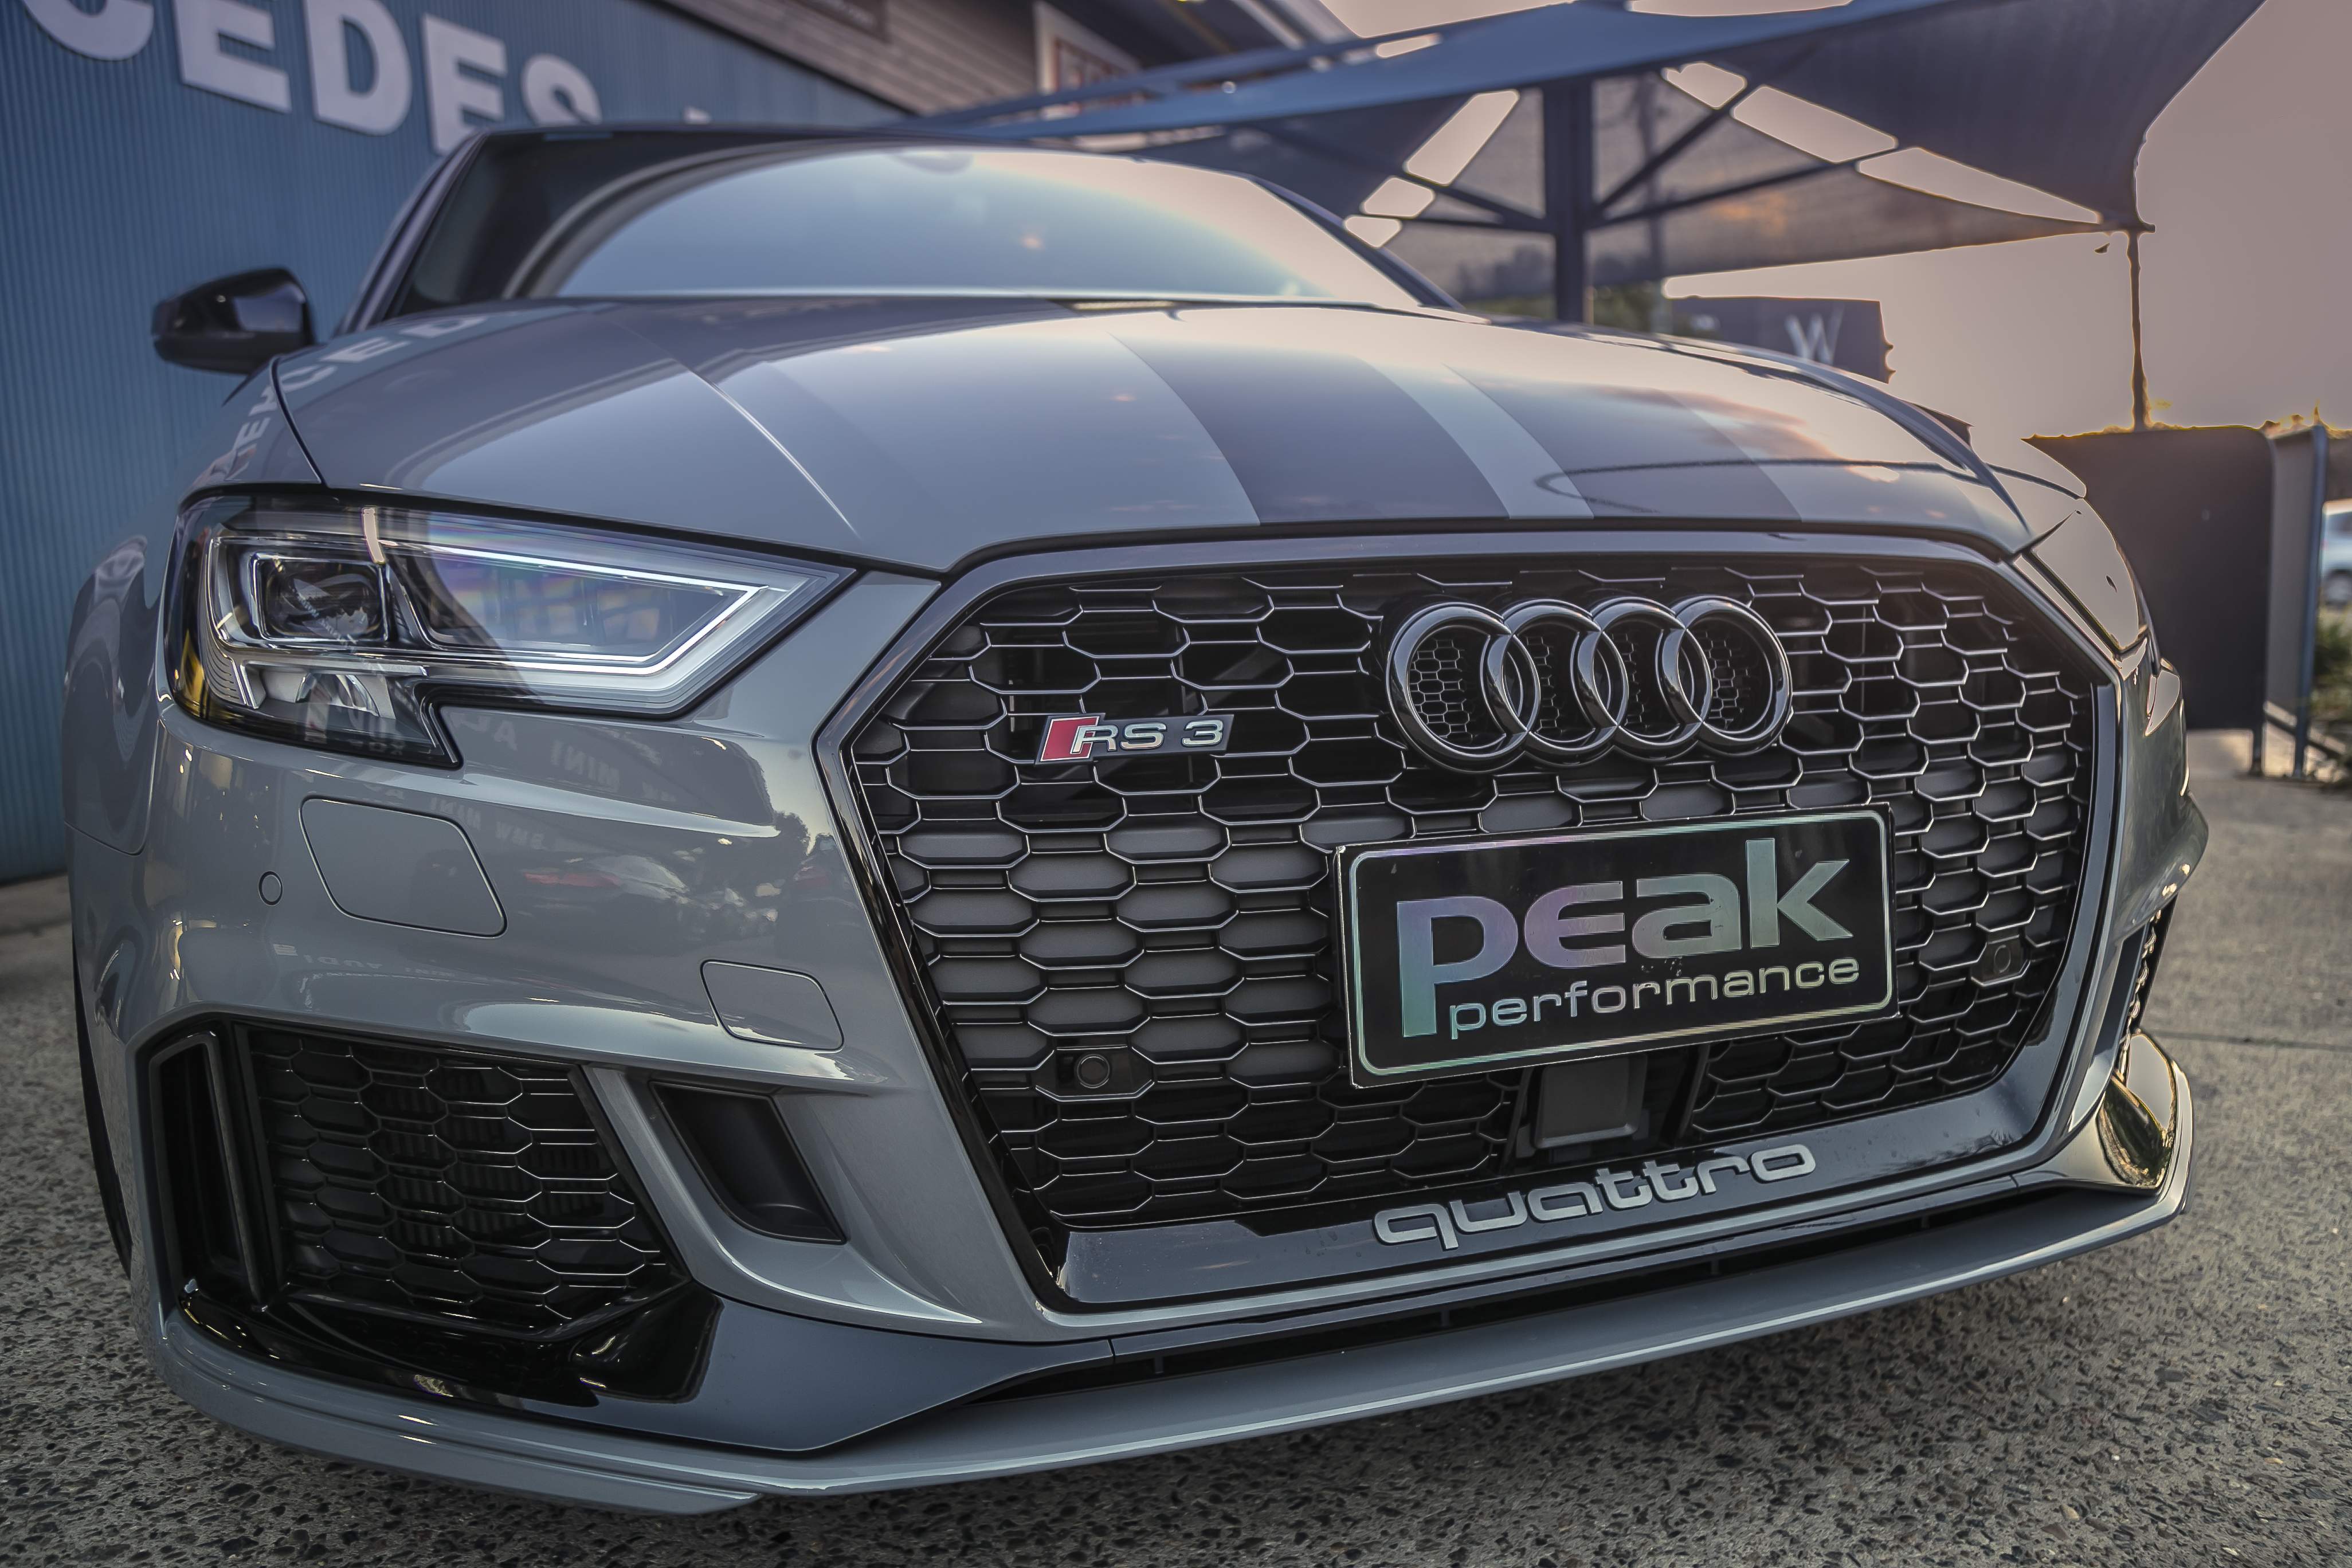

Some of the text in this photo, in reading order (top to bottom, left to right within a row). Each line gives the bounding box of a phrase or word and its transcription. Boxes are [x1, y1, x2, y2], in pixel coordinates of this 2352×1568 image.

[1069, 719, 1225, 755] RS 3
[1449, 958, 1860, 1040] performance
[1374, 1143, 1817, 1250] quattro
